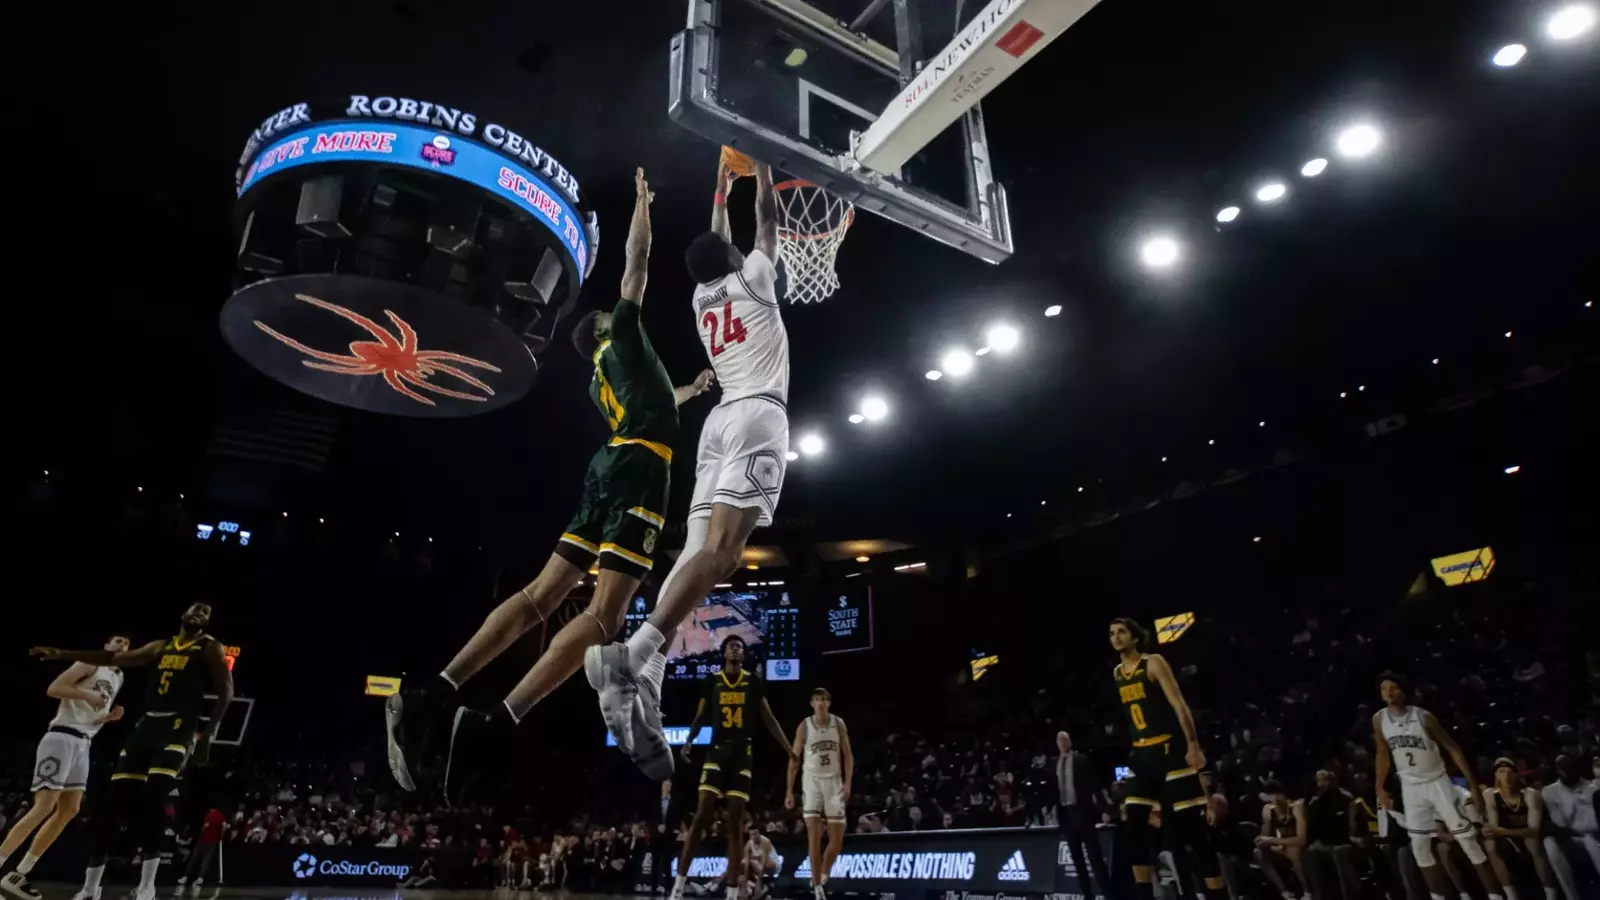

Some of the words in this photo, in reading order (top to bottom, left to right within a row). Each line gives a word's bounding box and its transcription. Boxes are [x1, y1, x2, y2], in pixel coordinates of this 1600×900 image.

[311, 131, 398, 153] MORE
[346, 95, 478, 134] ROBINS
[482, 123, 581, 203] CENTER
[497, 167, 561, 226] SCORE
[703, 301, 748, 359] 24
[827, 607, 860, 621] SOUTH
[828, 618, 859, 633] STATE
[157, 671, 174, 695] 5
[721, 706, 744, 729] 34
[1129, 703, 1149, 731] 0
[1405, 752, 1417, 767] 2
[898, 853, 913, 879] IS
[912, 851, 977, 880] NOTHING
[997, 870, 1031, 881] adidas
